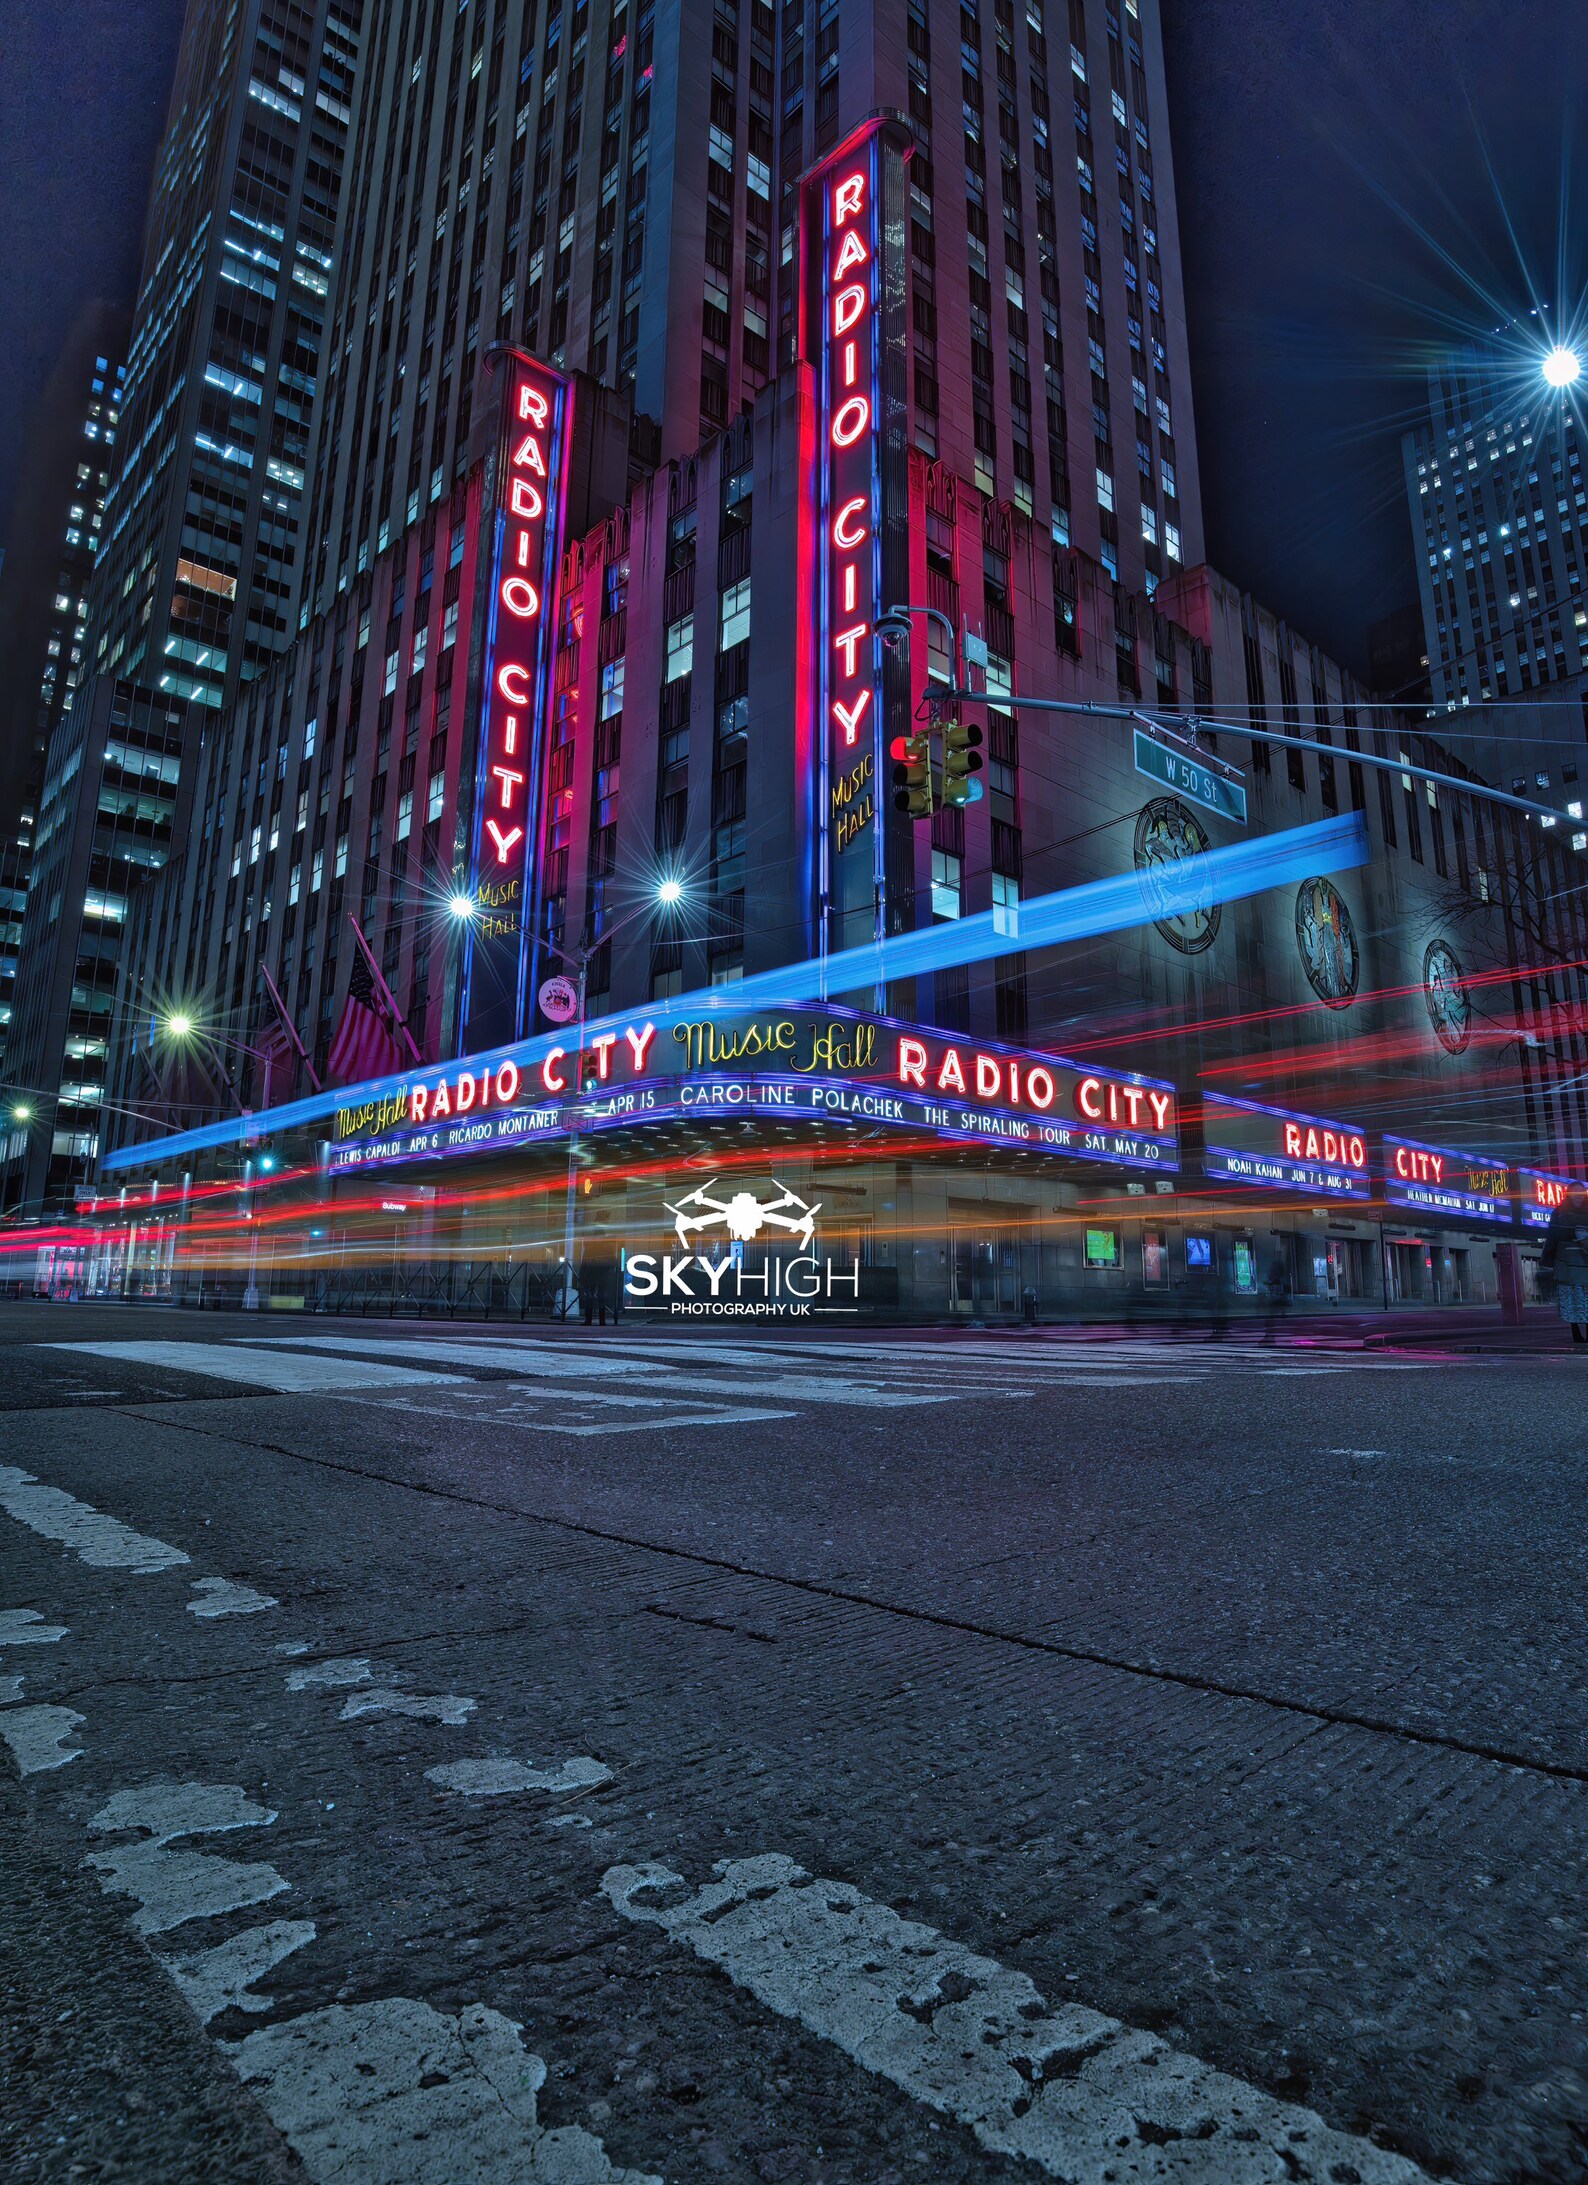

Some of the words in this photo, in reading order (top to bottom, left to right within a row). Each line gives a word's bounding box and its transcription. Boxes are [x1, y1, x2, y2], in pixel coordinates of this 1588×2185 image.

[831, 173, 869, 447] RADIO
[501, 384, 549, 618] RADIO
[832, 497, 871, 746] CITY
[485, 663, 531, 864] CITY
[831, 753, 874, 819] MUSIC
[1165, 756, 1176, 781] W
[1181, 766, 1198, 793] 50
[1203, 778, 1217, 803] St
[836, 795, 875, 853] HALL
[477, 880, 520, 908] MUSIC
[481, 912, 518, 942] HALL
[410, 1060, 520, 1123] RADIO
[541, 1022, 655, 1092] CTY
[672, 1020, 796, 1070] Music
[789, 1022, 880, 1072] Hall
[337, 1106, 375, 1140] Music
[369, 1084, 408, 1136] Hall
[899, 1037, 1055, 1109] RADIO
[1080, 1078, 1170, 1130] CITY
[339, 1149, 362, 1166] LEWIS
[365, 1141, 401, 1160] CAPALDI
[409, 1137, 428, 1152] APR
[431, 1133, 438, 1149] 6
[448, 1124, 493, 1145] RICARDO
[498, 1111, 558, 1136] MONTANER
[607, 1095, 635, 1116] APR
[641, 1091, 655, 1109] 15
[680, 1085, 795, 1105] CAROLINE
[812, 1088, 904, 1119] POLACHEK
[923, 1106, 950, 1127] THE
[961, 1113, 1030, 1139] SPIRALING
[1038, 1125, 1071, 1146] TOUR
[1115, 1140, 1138, 1157] MAY
[1144, 1144, 1159, 1160] 20
[1285, 1122, 1364, 1168] RADIO
[1227, 1157, 1252, 1175] NOAH
[1255, 1162, 1283, 1180] KAHAN
[1291, 1169, 1306, 1183] JUN
[1309, 1171, 1314, 1184] 7
[1327, 1175, 1341, 1189] AUG
[1396, 1148, 1443, 1183] CITY
[382, 1201, 407, 1212] Subway
